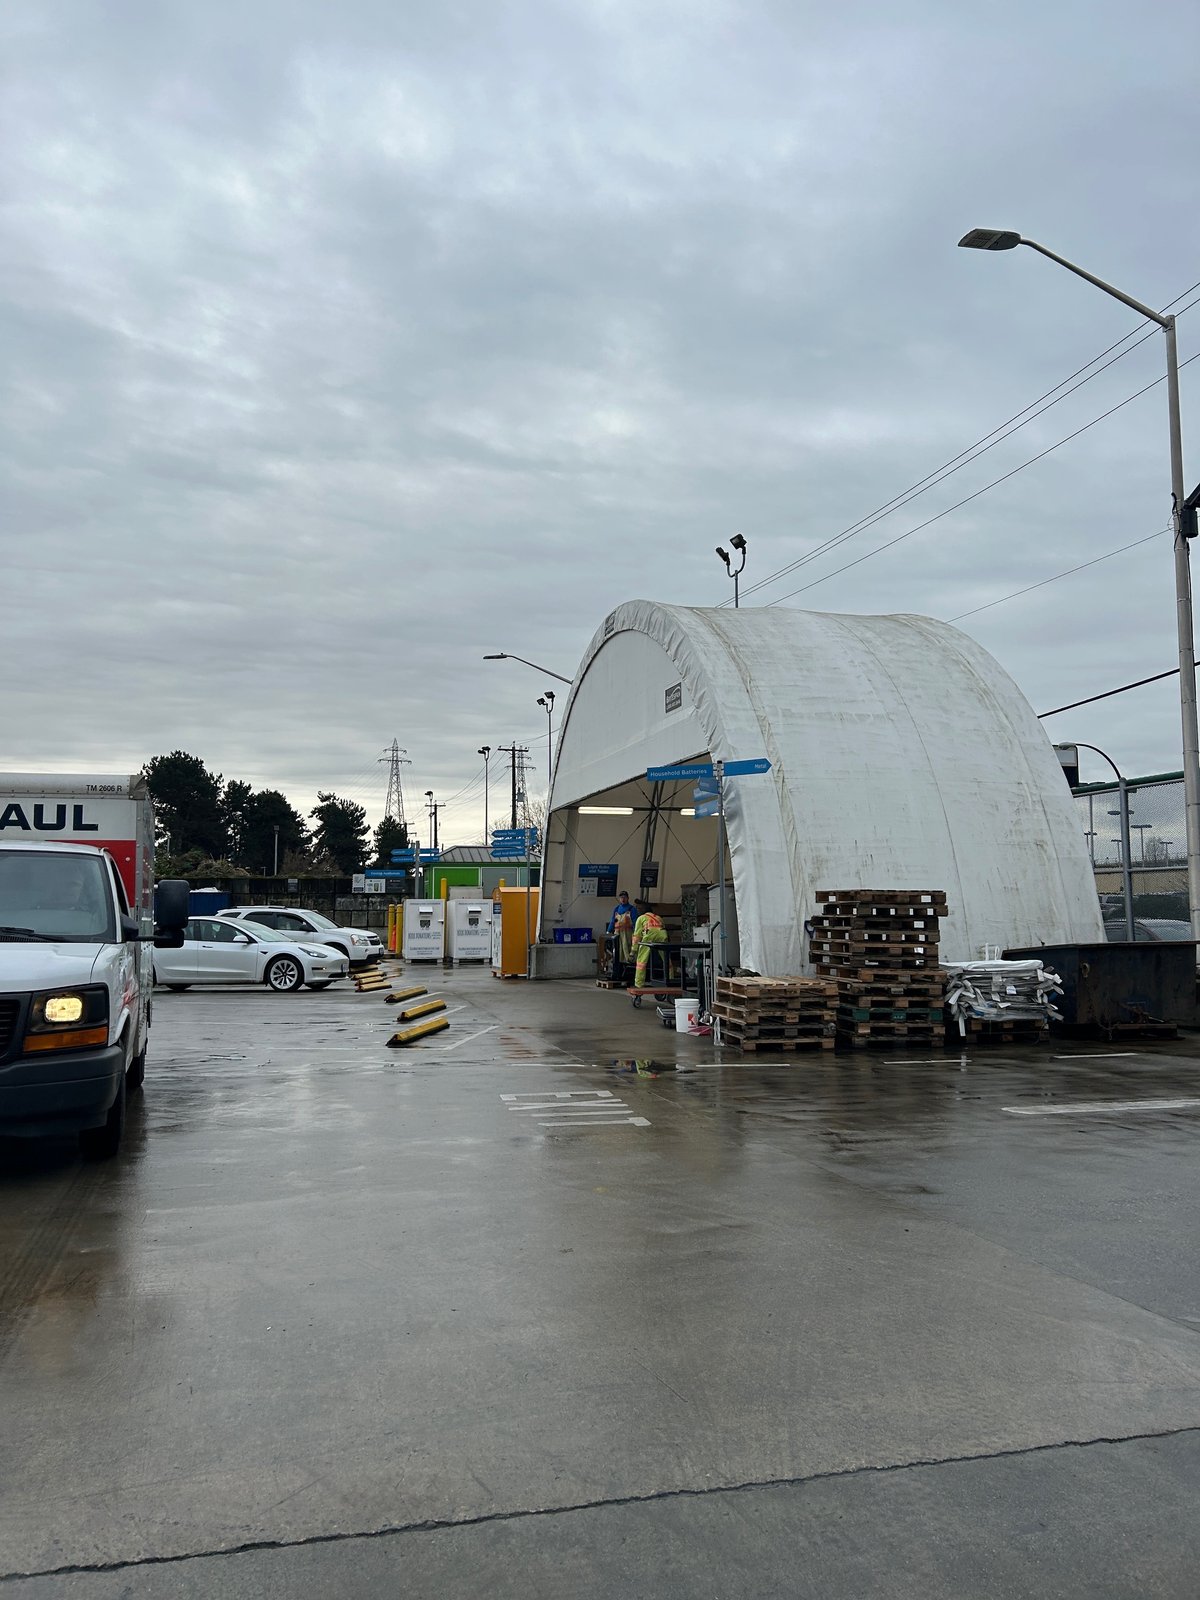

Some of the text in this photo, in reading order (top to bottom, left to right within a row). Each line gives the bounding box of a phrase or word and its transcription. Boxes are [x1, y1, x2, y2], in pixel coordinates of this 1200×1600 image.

[86, 784, 122, 792] TM 2606 R
[0, 803, 98, 831] AUL
